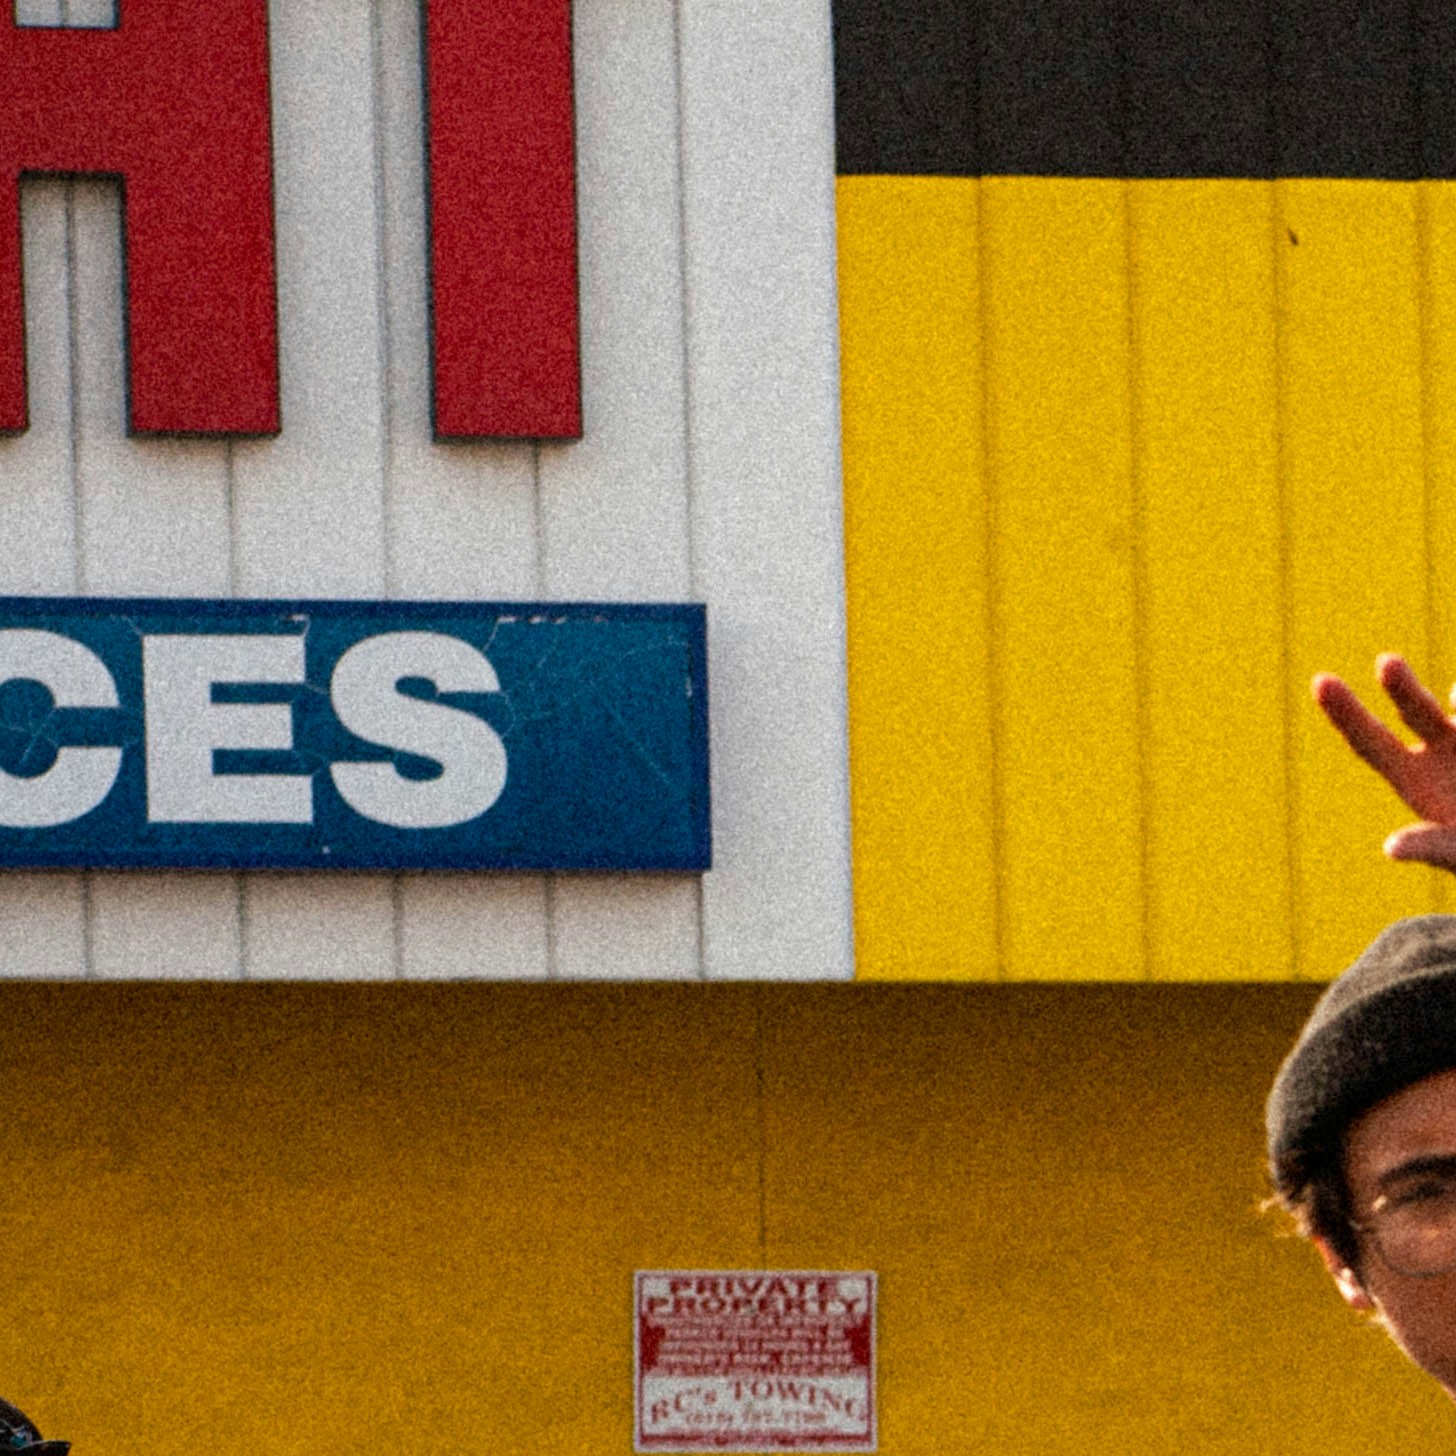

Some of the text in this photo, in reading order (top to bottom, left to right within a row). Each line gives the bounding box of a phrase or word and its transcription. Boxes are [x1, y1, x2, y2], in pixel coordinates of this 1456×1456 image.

[669, 1277, 838, 1296] PRIVATE
[646, 1296, 861, 1314] PROPERTY
[729, 1379, 867, 1422] TOWING
